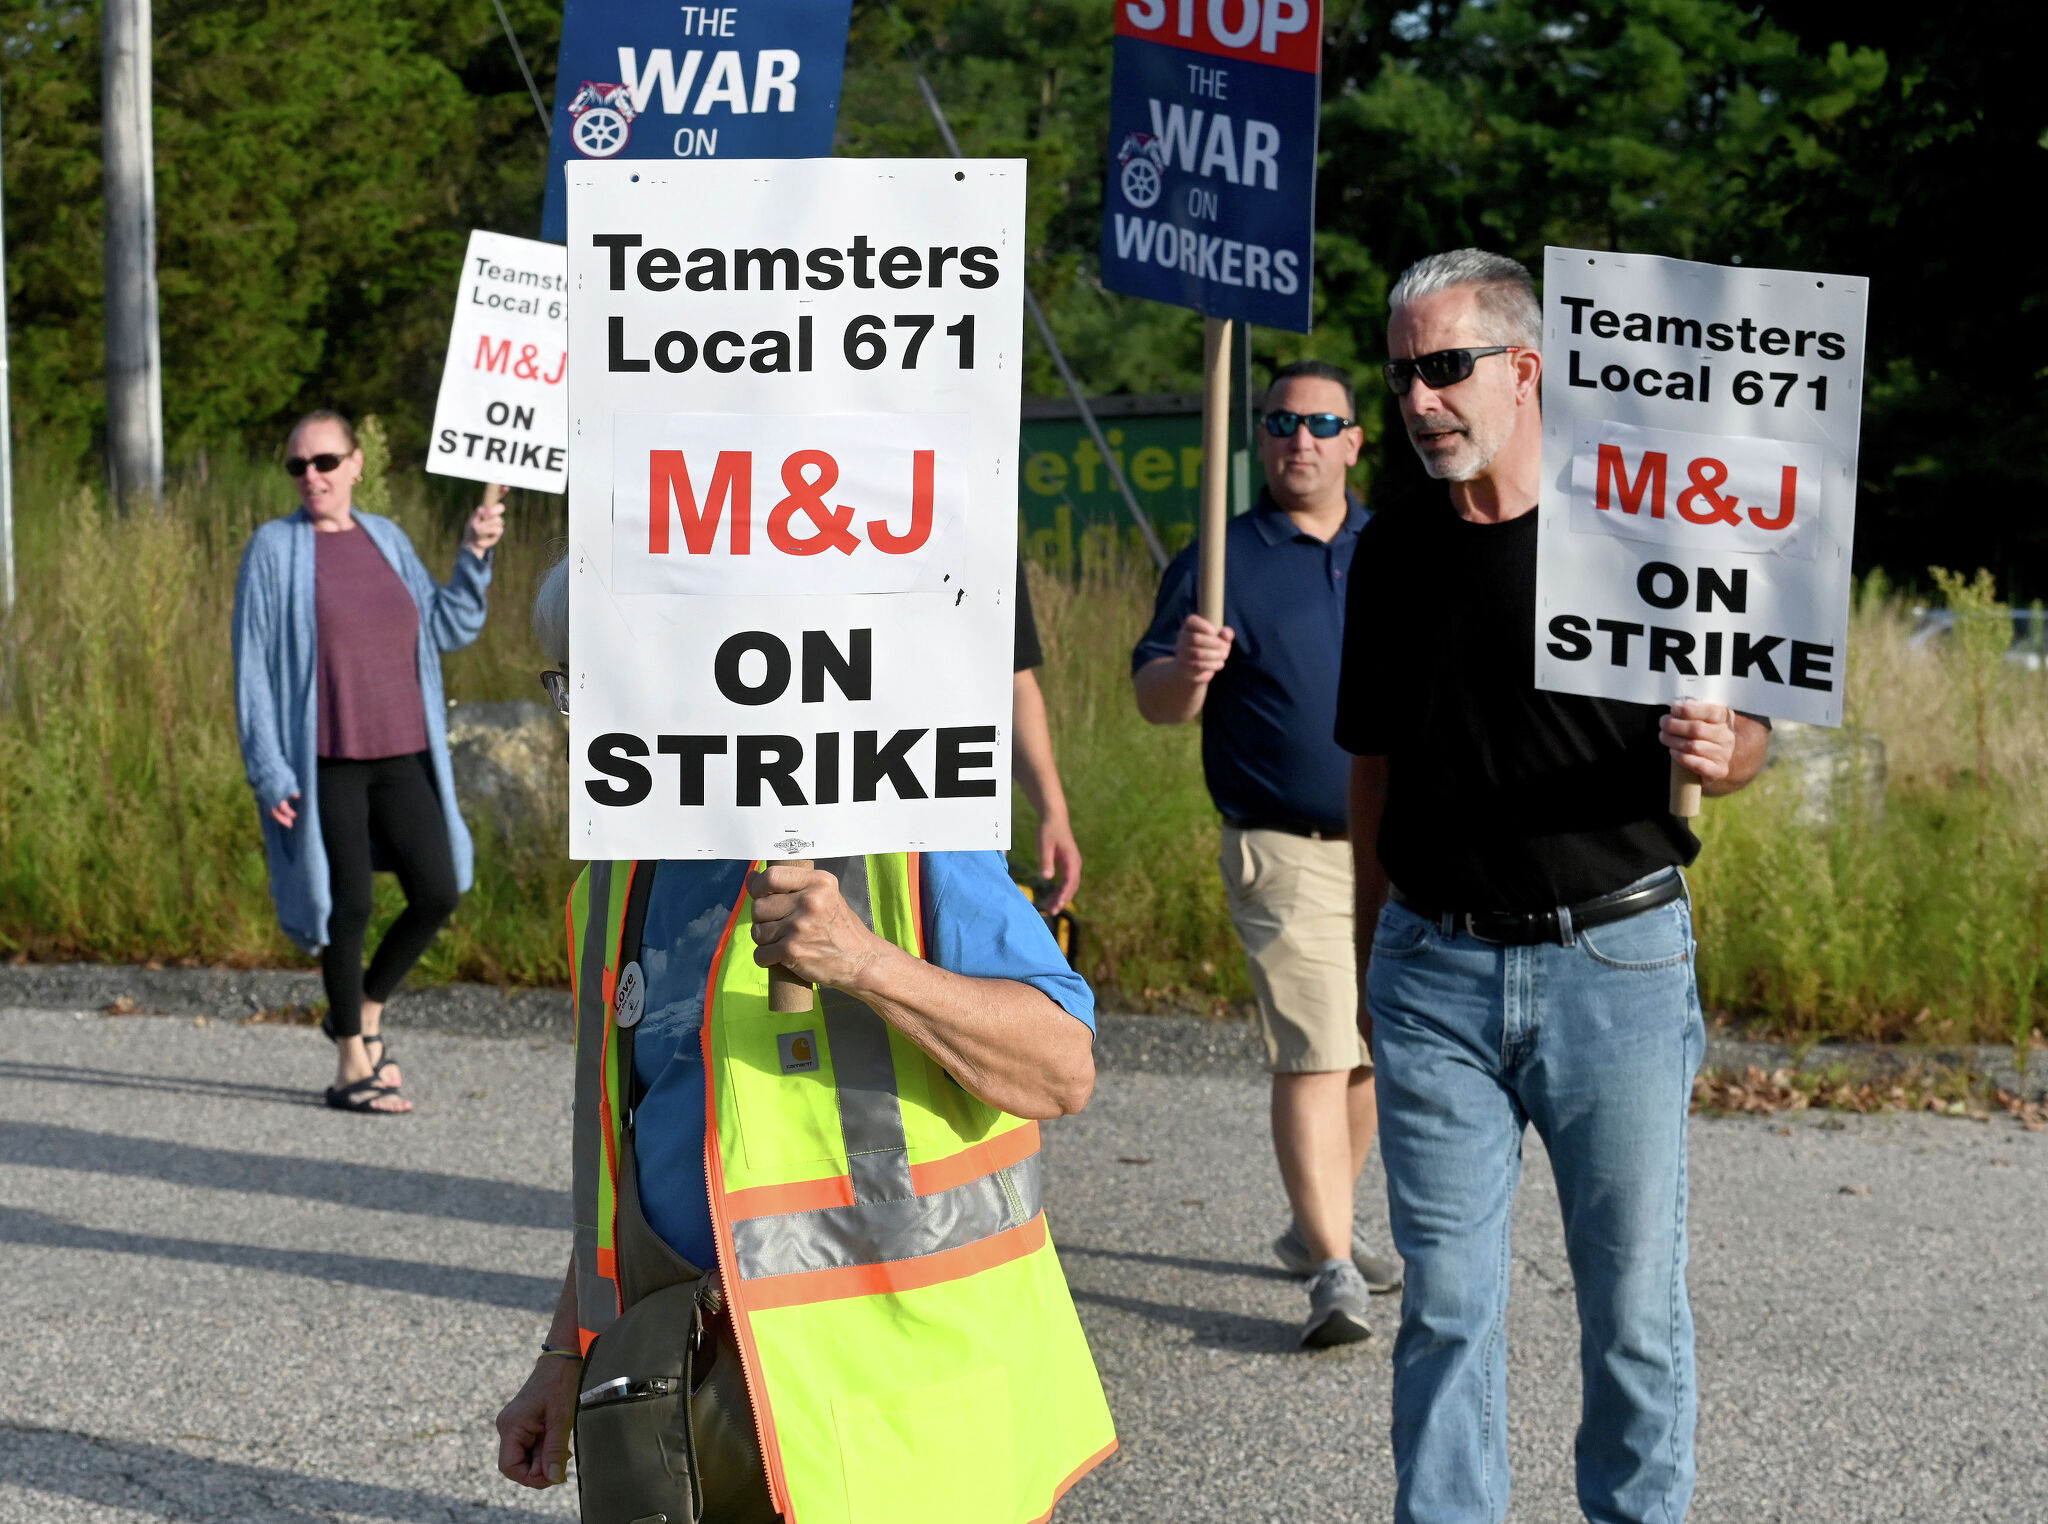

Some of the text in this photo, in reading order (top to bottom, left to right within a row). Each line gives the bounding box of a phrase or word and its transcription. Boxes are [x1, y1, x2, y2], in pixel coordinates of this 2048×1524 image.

[681, 6, 736, 37] THE
[617, 47, 800, 115] WAR
[1187, 64, 1229, 100] THE
[673, 128, 718, 156] ON
[1149, 98, 1281, 191] WAR
[1187, 187, 1218, 222] ON
[476, 257, 567, 292] Teamst
[593, 234, 999, 291] Teamsters
[1114, 213, 1299, 295] WORKERS
[472, 286, 539, 315] Local
[1560, 296, 1846, 361] Teamsters
[474, 335, 567, 384] M&J
[607, 314, 975, 373] Local 671
[1568, 350, 1828, 411] Local 671
[486, 401, 535, 431] ON
[438, 429, 566, 472] STRIKE
[649, 449, 935, 556] M&J
[1595, 443, 1798, 531] M&J
[1636, 561, 1748, 613] ON
[714, 628, 872, 706] ON
[1546, 615, 1834, 692] STRIKE
[584, 725, 996, 807] STRIKE
[614, 973, 634, 1012] Love
